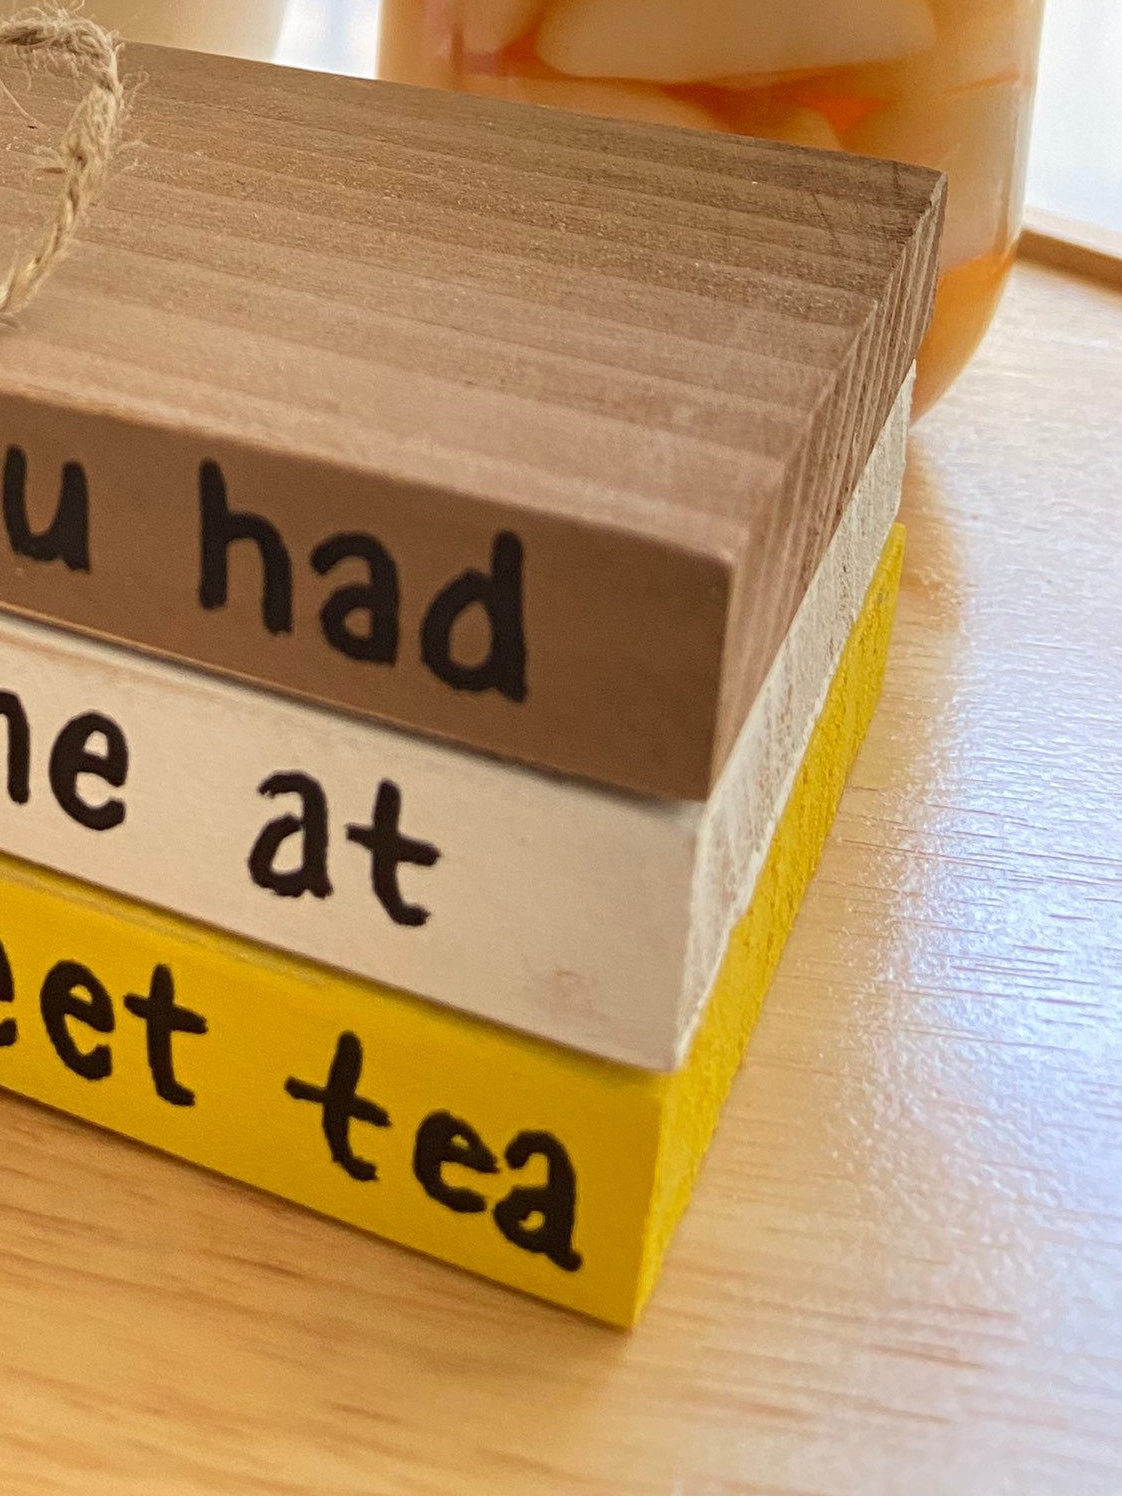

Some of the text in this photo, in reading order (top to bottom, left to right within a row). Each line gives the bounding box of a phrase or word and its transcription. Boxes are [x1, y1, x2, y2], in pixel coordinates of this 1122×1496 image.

[197, 457, 530, 705] had
[247, 768, 442, 927] at
[284, 1029, 583, 1273] tea
